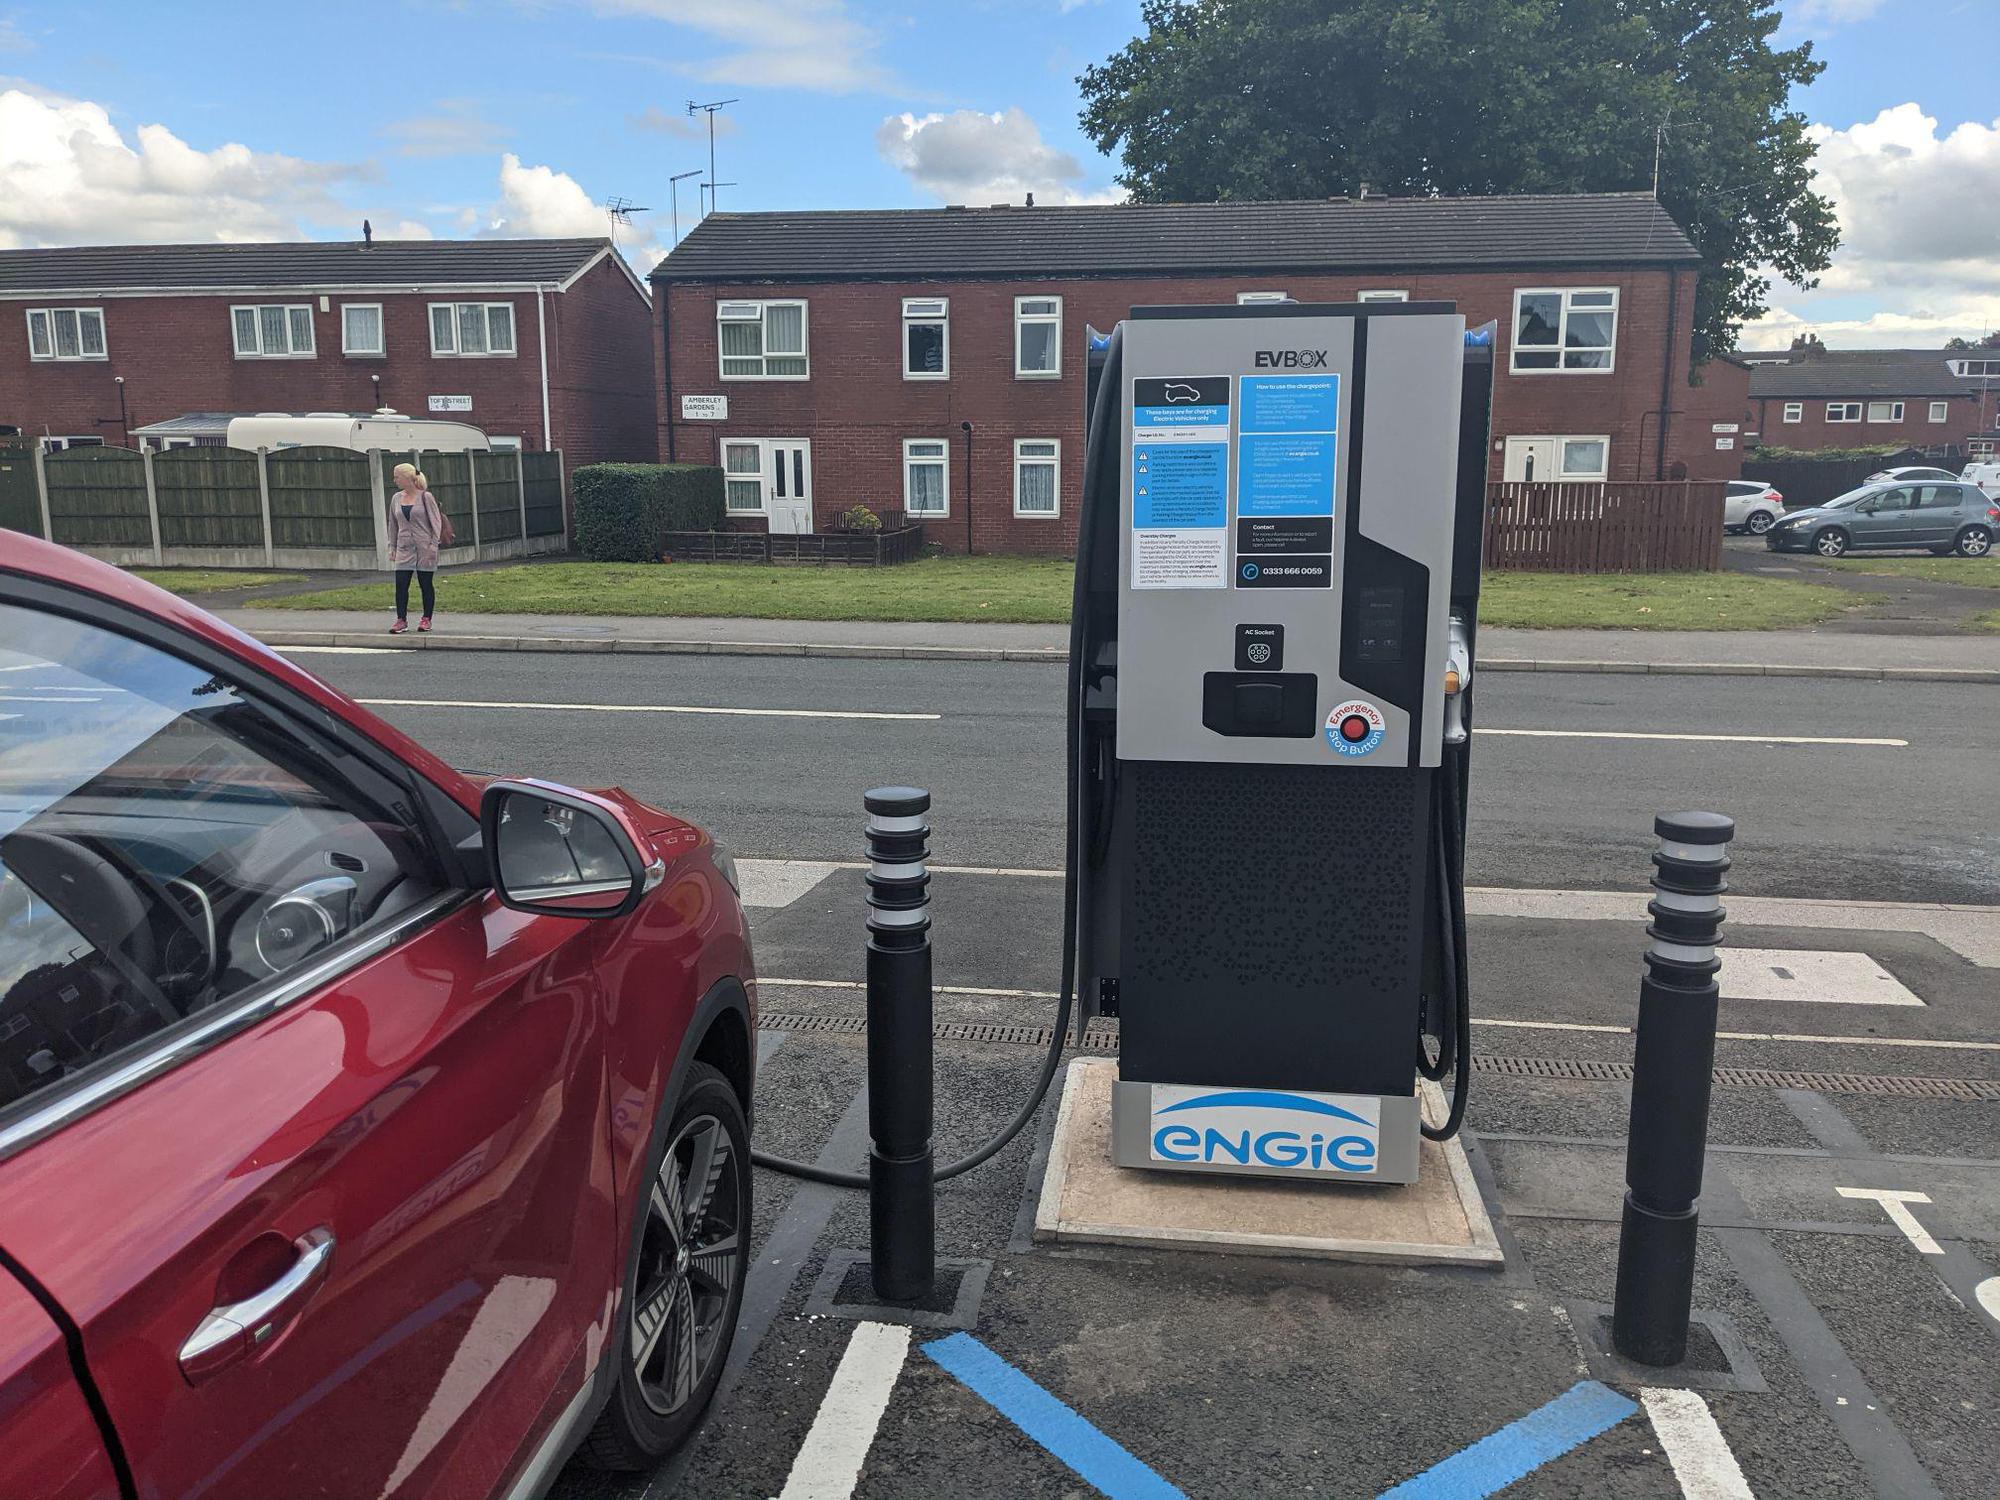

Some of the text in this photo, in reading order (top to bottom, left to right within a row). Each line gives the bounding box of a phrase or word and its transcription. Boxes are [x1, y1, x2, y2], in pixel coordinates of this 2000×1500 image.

[1255, 350, 1327, 368] EVBOX
[1330, 704, 1381, 725] Emergency
[1329, 731, 1381, 754] Stop Button
